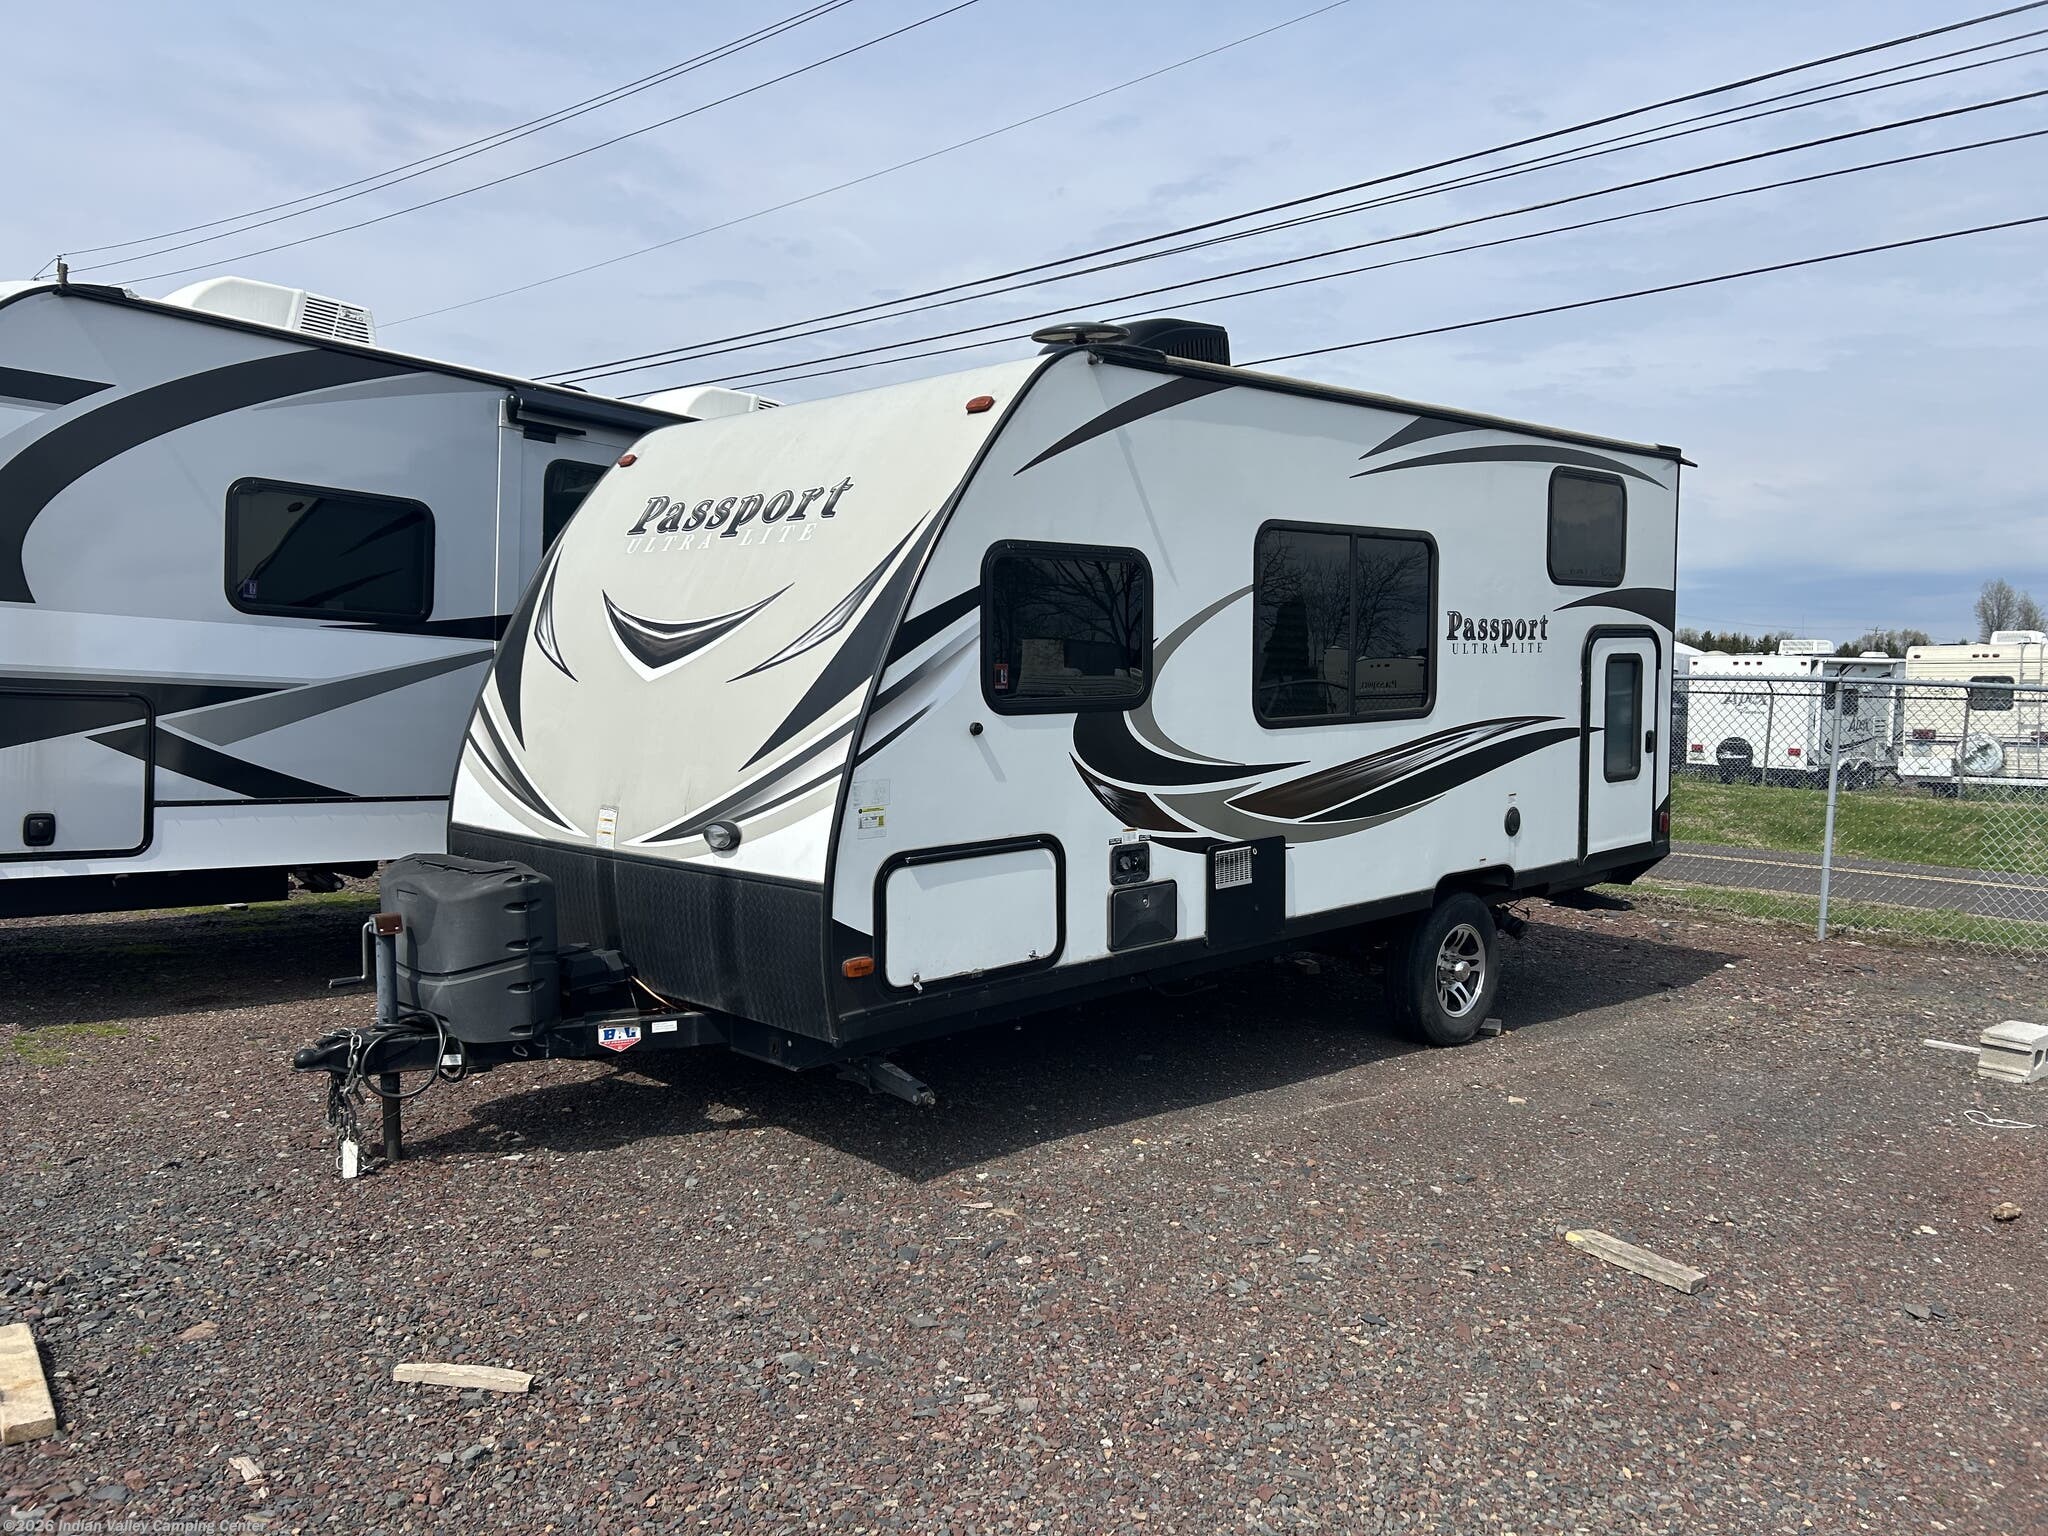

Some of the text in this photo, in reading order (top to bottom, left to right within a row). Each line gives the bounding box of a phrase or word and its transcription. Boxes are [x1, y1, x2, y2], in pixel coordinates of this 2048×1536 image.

[626, 477, 854, 538] Passport
[626, 523, 818, 554] ULTRA LITE
[1446, 611, 1549, 647] Passport
[1452, 642, 1543, 654] ULTRA LITE
